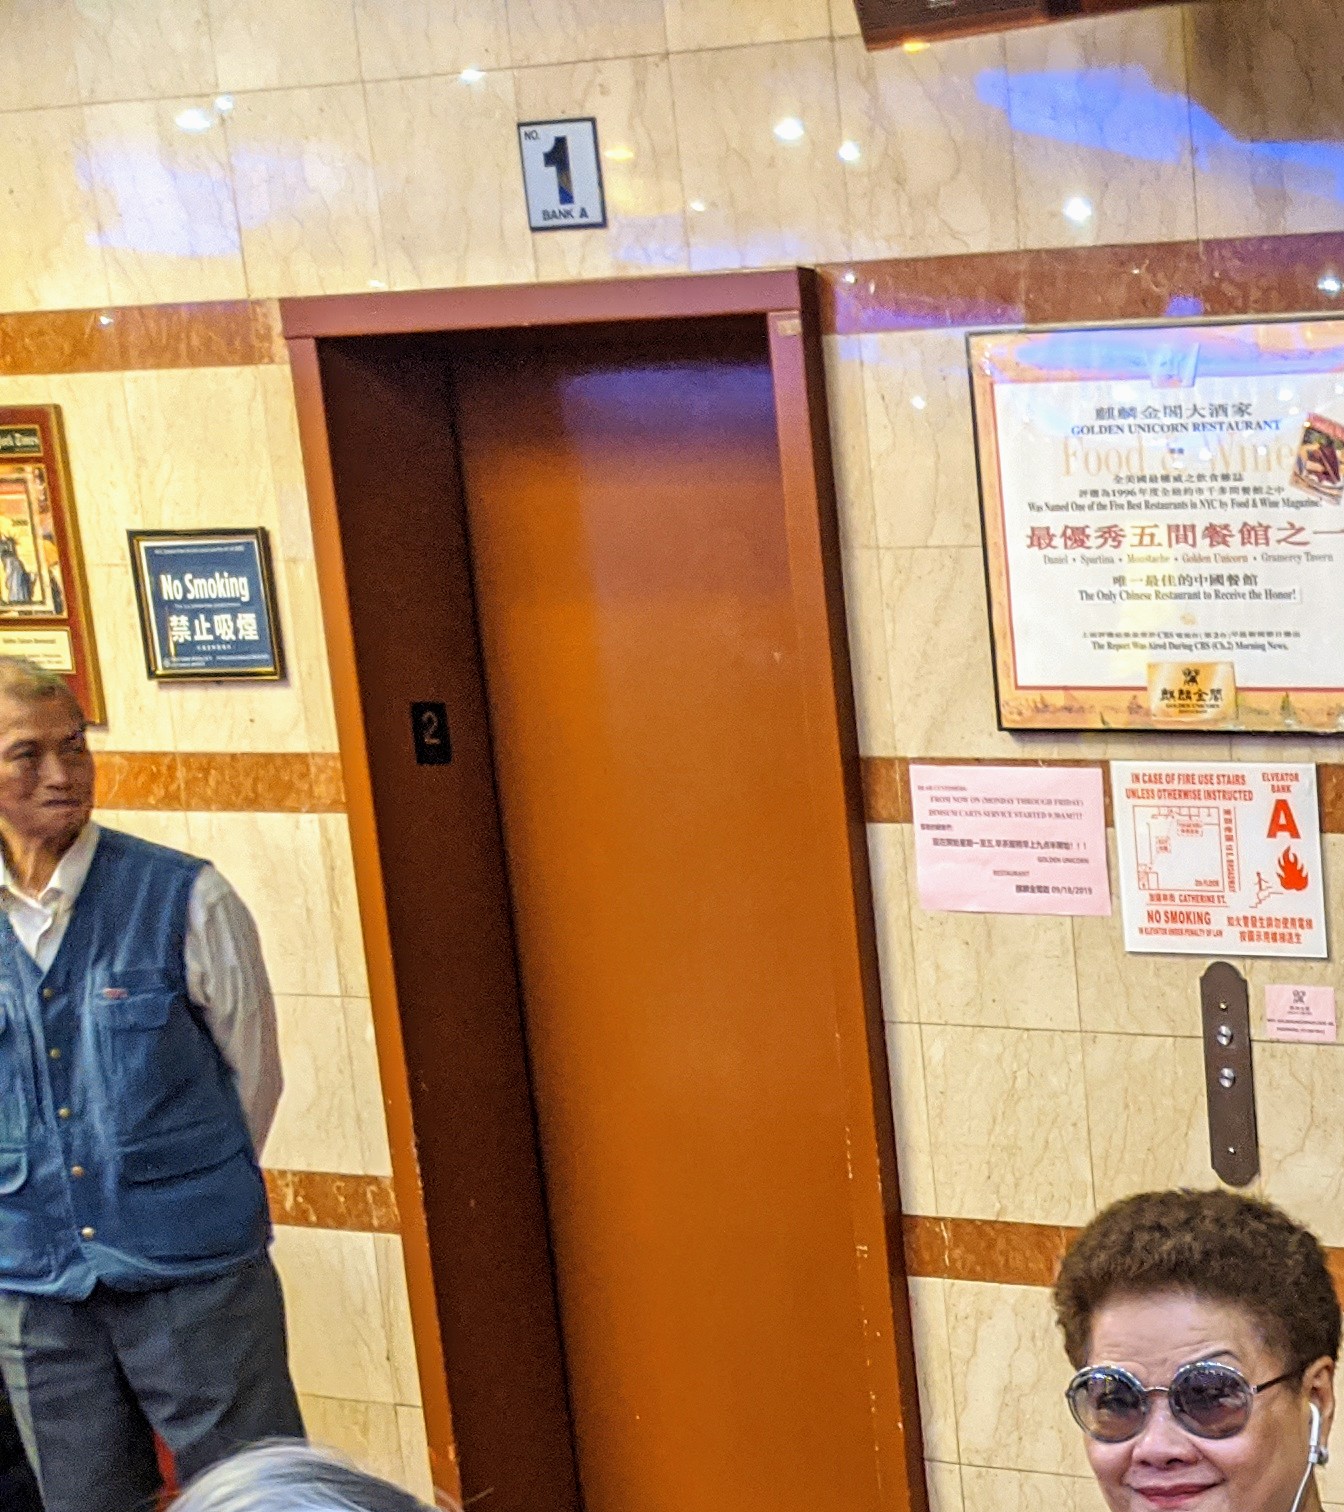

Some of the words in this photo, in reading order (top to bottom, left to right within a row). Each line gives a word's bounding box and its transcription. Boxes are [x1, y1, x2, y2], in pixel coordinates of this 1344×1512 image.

[543, 135, 574, 205] 1
[542, 209, 574, 221] BANK
[579, 207, 589, 219] A
[1071, 424, 1124, 436] GOLDEN
[1128, 422, 1189, 434] UNICORN
[1193, 419, 1281, 432] RESTAURANT
[1062, 434, 1146, 476] Food
[1045, 502, 1069, 512] Named
[1071, 501, 1085, 511] One
[1087, 501, 1096, 510] of
[1097, 501, 1107, 510] the
[1127, 500, 1141, 510] Best
[1144, 499, 1189, 510] Restaurants
[1201, 499, 1218, 509] NYC
[1231, 498, 1251, 508] Food
[1182, 553, 1211, 563] Golden
[1214, 553, 1248, 563] Unicorn
[160, 574, 183, 600] No
[184, 571, 250, 602] Smoking
[1078, 590, 1094, 601] The
[1096, 590, 1116, 603] Only
[1119, 590, 1152, 600] Chinese
[1155, 589, 1201, 600] Restaurant
[1203, 591, 1212, 600] to
[1214, 589, 1247, 600] Receive
[1248, 589, 1262, 600] the
[1264, 589, 1296, 600] Honor!
[169, 613, 259, 643] 禁止吸煙
[422, 711, 441, 745] 2
[1131, 773, 1141, 783] IN
[1142, 773, 1164, 784] CASE
[1165, 773, 1176, 784] OF
[1177, 773, 1196, 785] FIRE
[1198, 773, 1214, 785] USE
[1216, 774, 1246, 786] STAIRS
[1125, 788, 1155, 800] UNLESS
[1157, 788, 1201, 801] OTHERWISE
[1203, 789, 1253, 801] INSTRUCTED
[1270, 784, 1291, 793] BANK
[1266, 798, 1301, 839] A
[1147, 910, 1161, 924] NO
[1164, 910, 1212, 925] SMOKING
